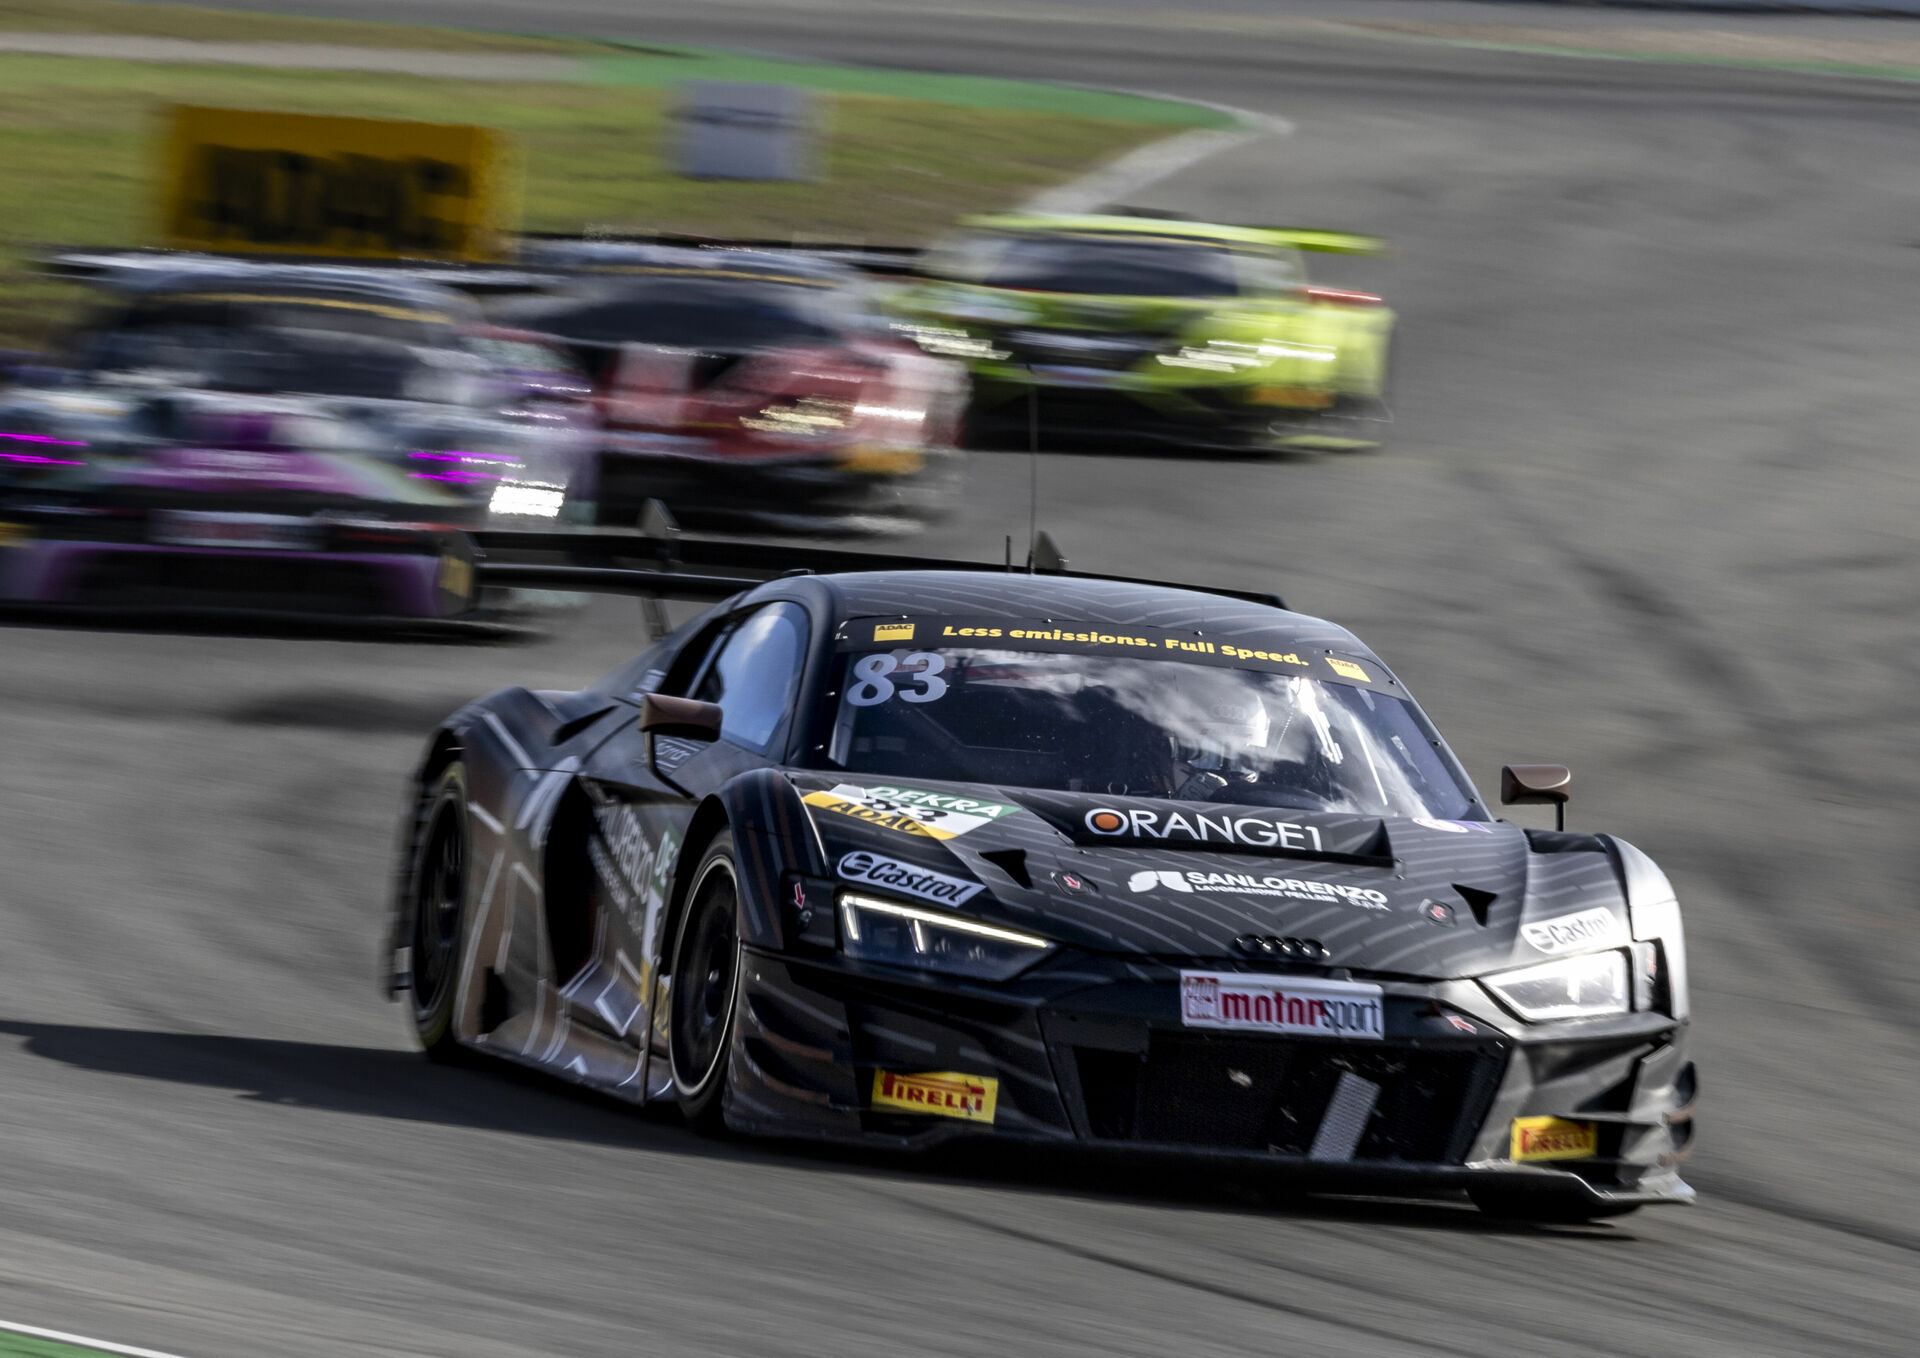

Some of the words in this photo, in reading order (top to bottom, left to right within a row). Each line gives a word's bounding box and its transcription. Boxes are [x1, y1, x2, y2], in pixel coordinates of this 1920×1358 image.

[943, 626, 1002, 637] Less
[1009, 629, 1157, 647] emissions.
[1165, 639, 1215, 654] Full
[1221, 645, 1310, 666] Speed.
[846, 652, 947, 707] 83
[827, 803, 921, 832] ADAC
[866, 786, 1003, 818] DEKRA
[1084, 808, 1323, 852] ORANGE1
[866, 861, 967, 901] Castrol
[1187, 871, 1388, 903] SANLORENZO
[1222, 992, 1381, 1037] motorsport
[882, 1071, 986, 1113] PIRELLI
